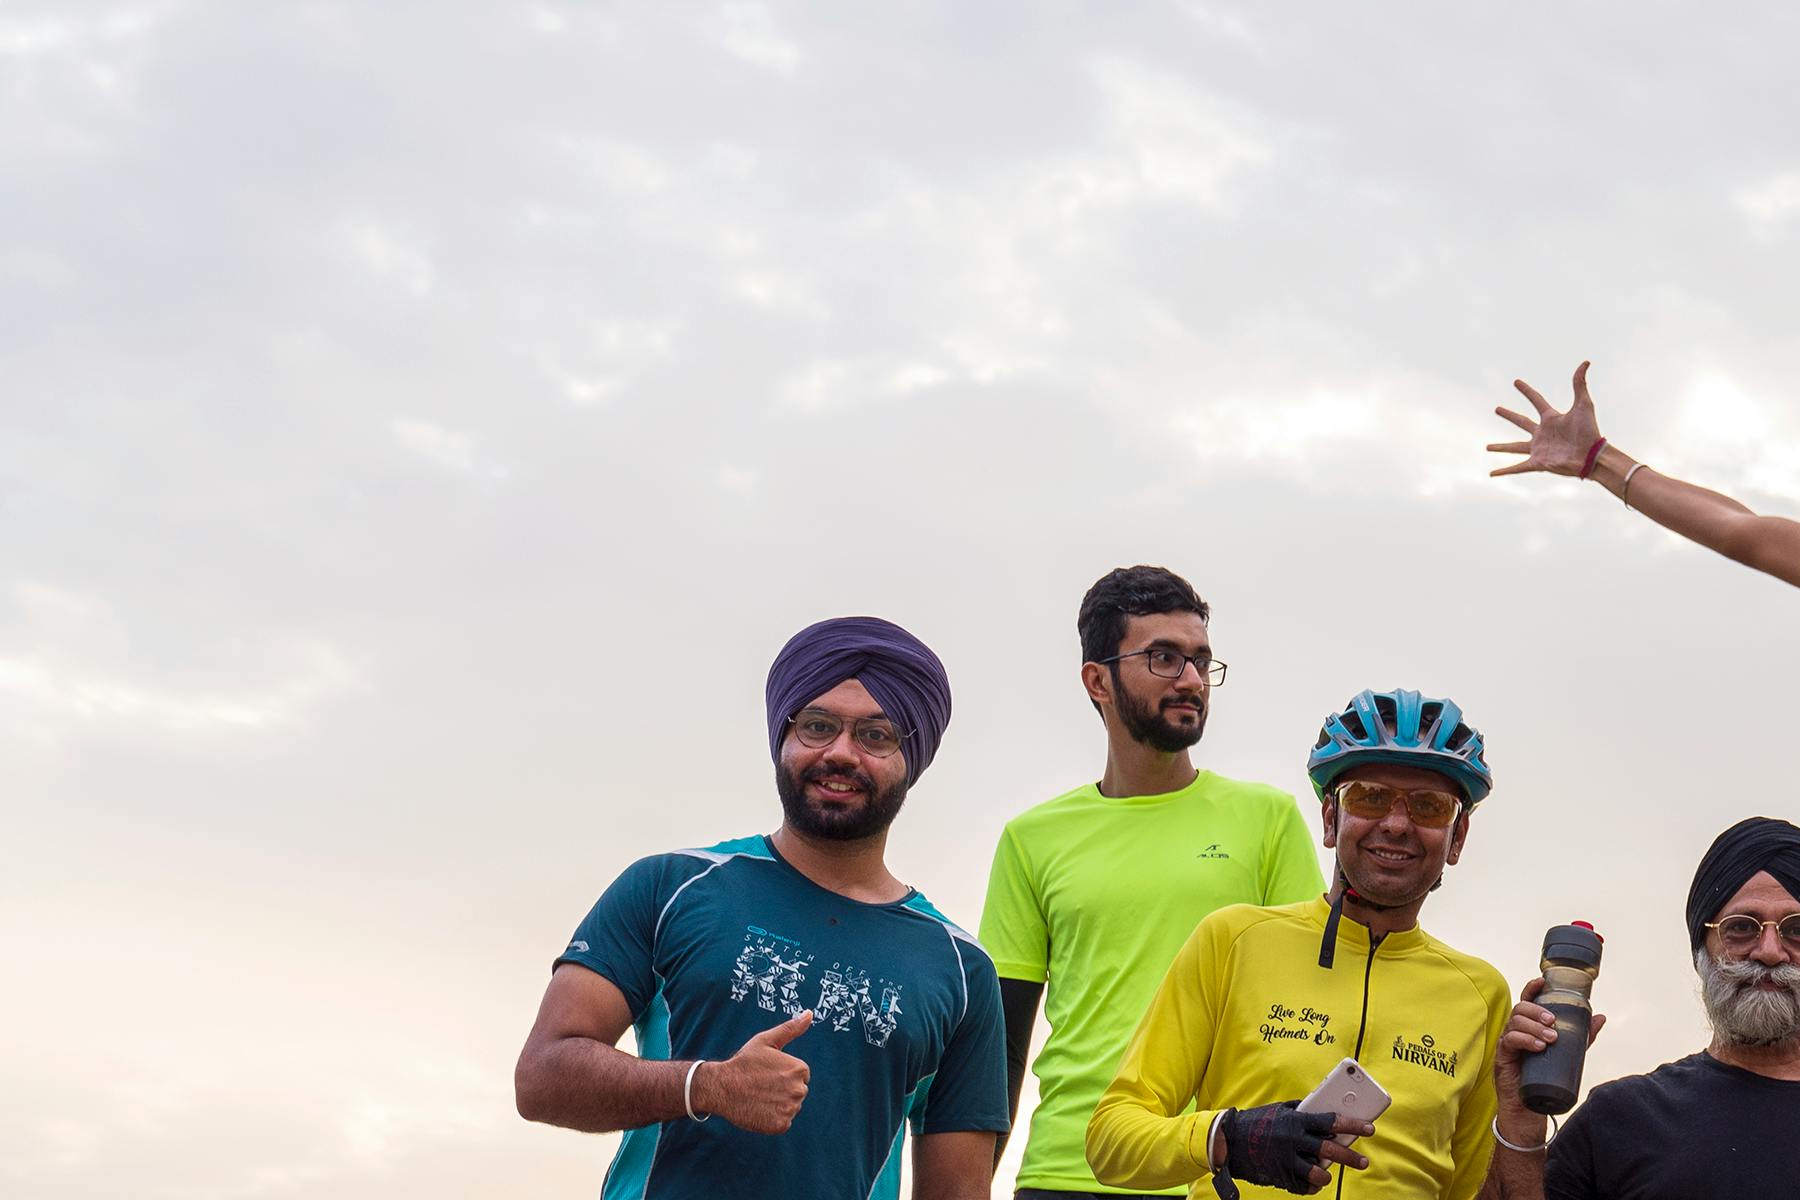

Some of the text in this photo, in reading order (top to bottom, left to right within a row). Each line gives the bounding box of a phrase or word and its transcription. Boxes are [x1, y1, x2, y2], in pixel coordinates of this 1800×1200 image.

[744, 934, 815, 962] SWITCH
[833, 962, 866, 977] OFF
[1268, 1004, 1330, 1028] Live Long
[1260, 1024, 1336, 1046] Helmets On
[1392, 1046, 1455, 1078] NIRVANA
[1408, 1042, 1447, 1060] PEDALS OF
